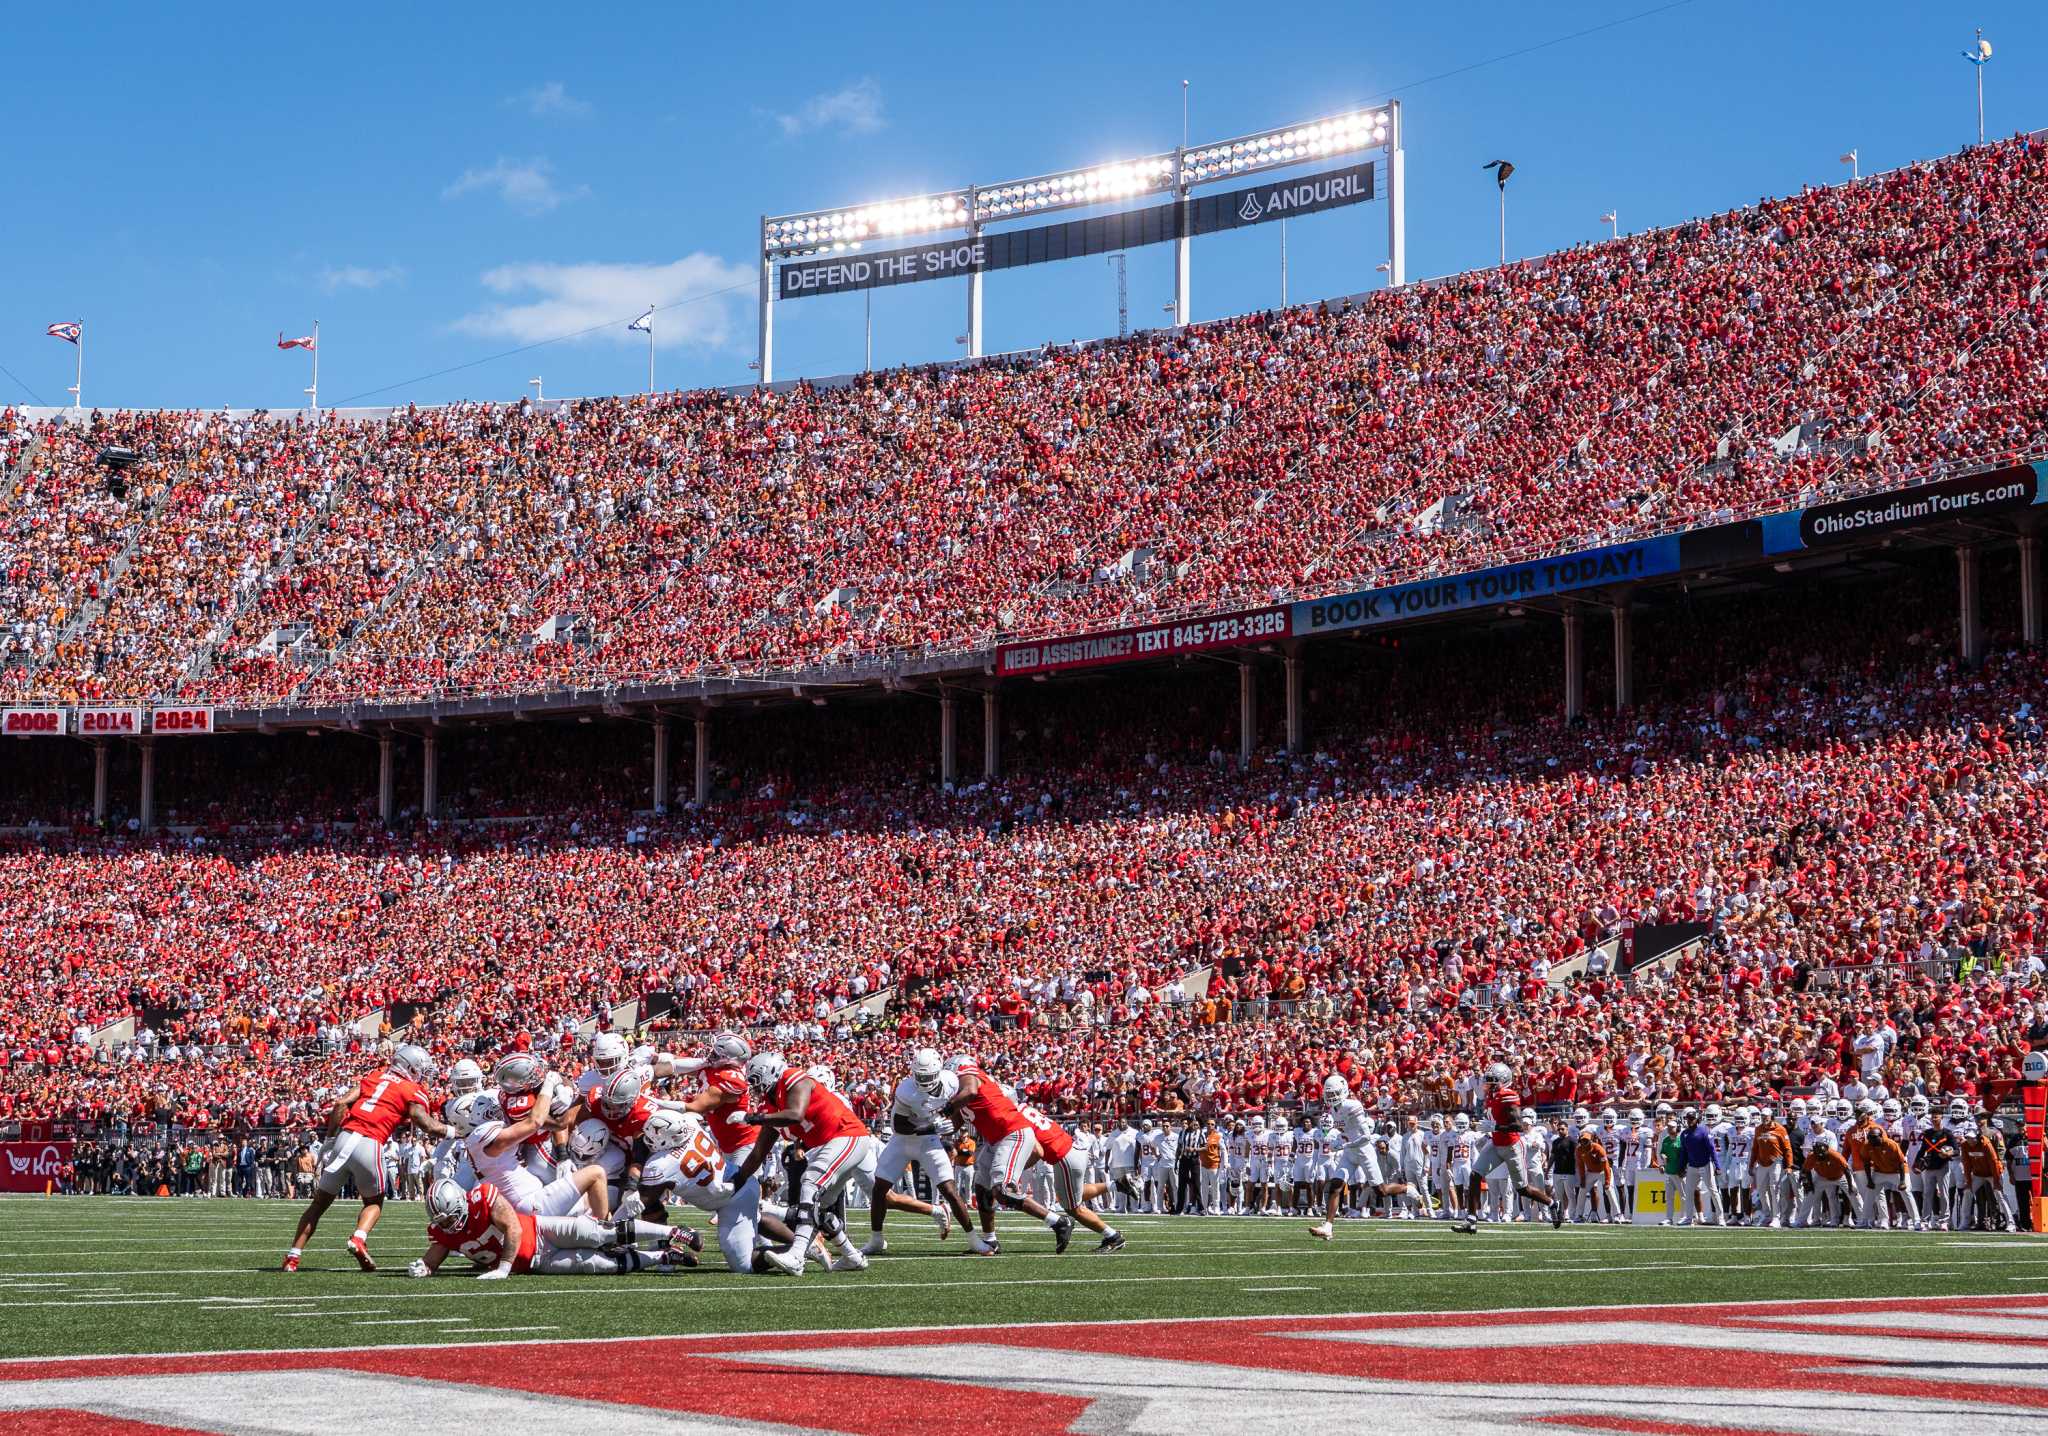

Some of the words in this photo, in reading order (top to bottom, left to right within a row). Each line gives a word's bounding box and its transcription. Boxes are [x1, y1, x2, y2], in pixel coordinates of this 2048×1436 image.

[1266, 174, 1366, 213] ANDURIL
[787, 262, 871, 291] DEFEND
[874, 255, 918, 279] THE
[922, 244, 986, 272] 'SHOE
[1813, 481, 2025, 535] OhioStadiumTours.com
[1311, 599, 1381, 628] BOOK
[1389, 583, 1459, 615] YOUR
[1465, 571, 1536, 601] TOUR
[1541, 548, 1645, 585] TODAY!
[1004, 647, 1039, 671] NEED
[1042, 634, 1134, 666] ASSISTANCE?
[1136, 628, 1169, 653] TEXT
[1173, 612, 1286, 648] 845-723-3326
[7, 712, 58, 732] 2002
[83, 712, 134, 730] 2014
[155, 710, 207, 729] 2024
[360, 1081, 391, 1113] 1
[679, 1130, 727, 1188] 99
[1627, 1142, 1640, 1157] 17
